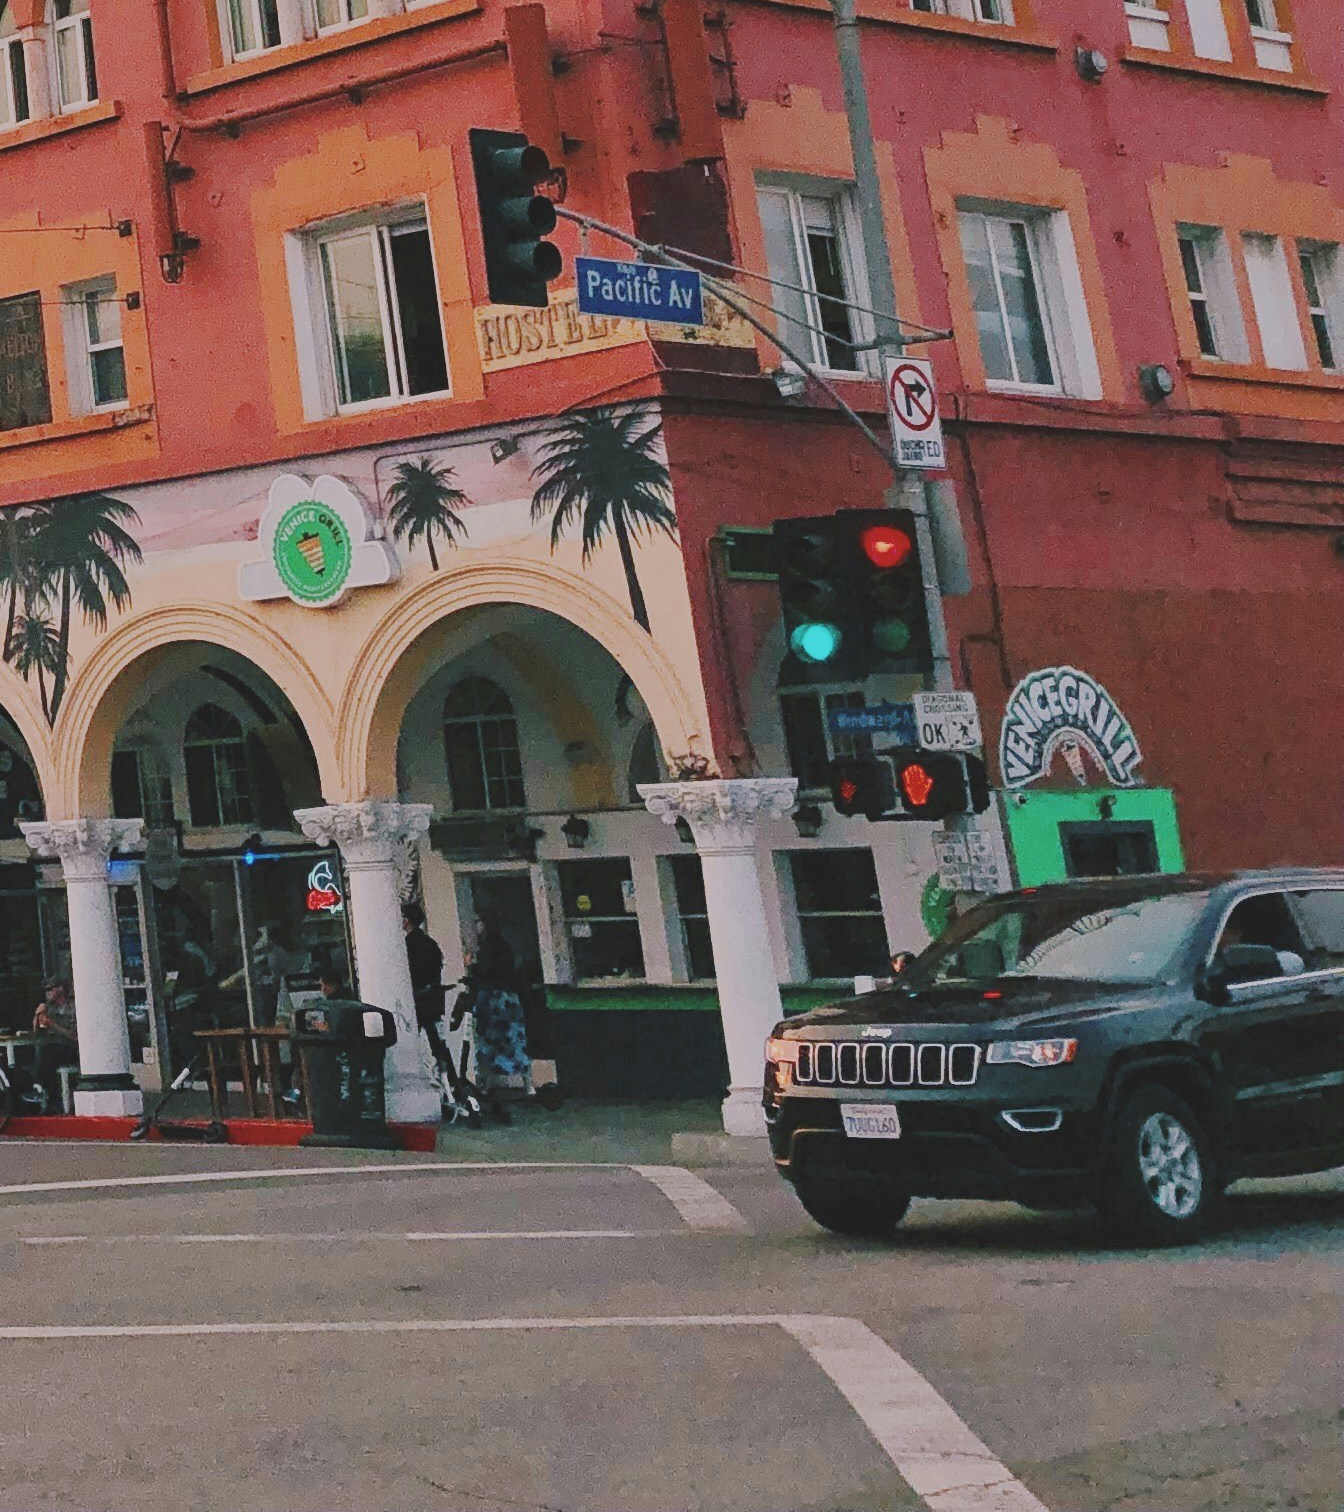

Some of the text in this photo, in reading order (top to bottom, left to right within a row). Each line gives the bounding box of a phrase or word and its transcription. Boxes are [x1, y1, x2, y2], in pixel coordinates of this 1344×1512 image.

[586, 269, 693, 310] Pacific Av
[279, 510, 315, 542] VENICE
[922, 722, 947, 745] OK
